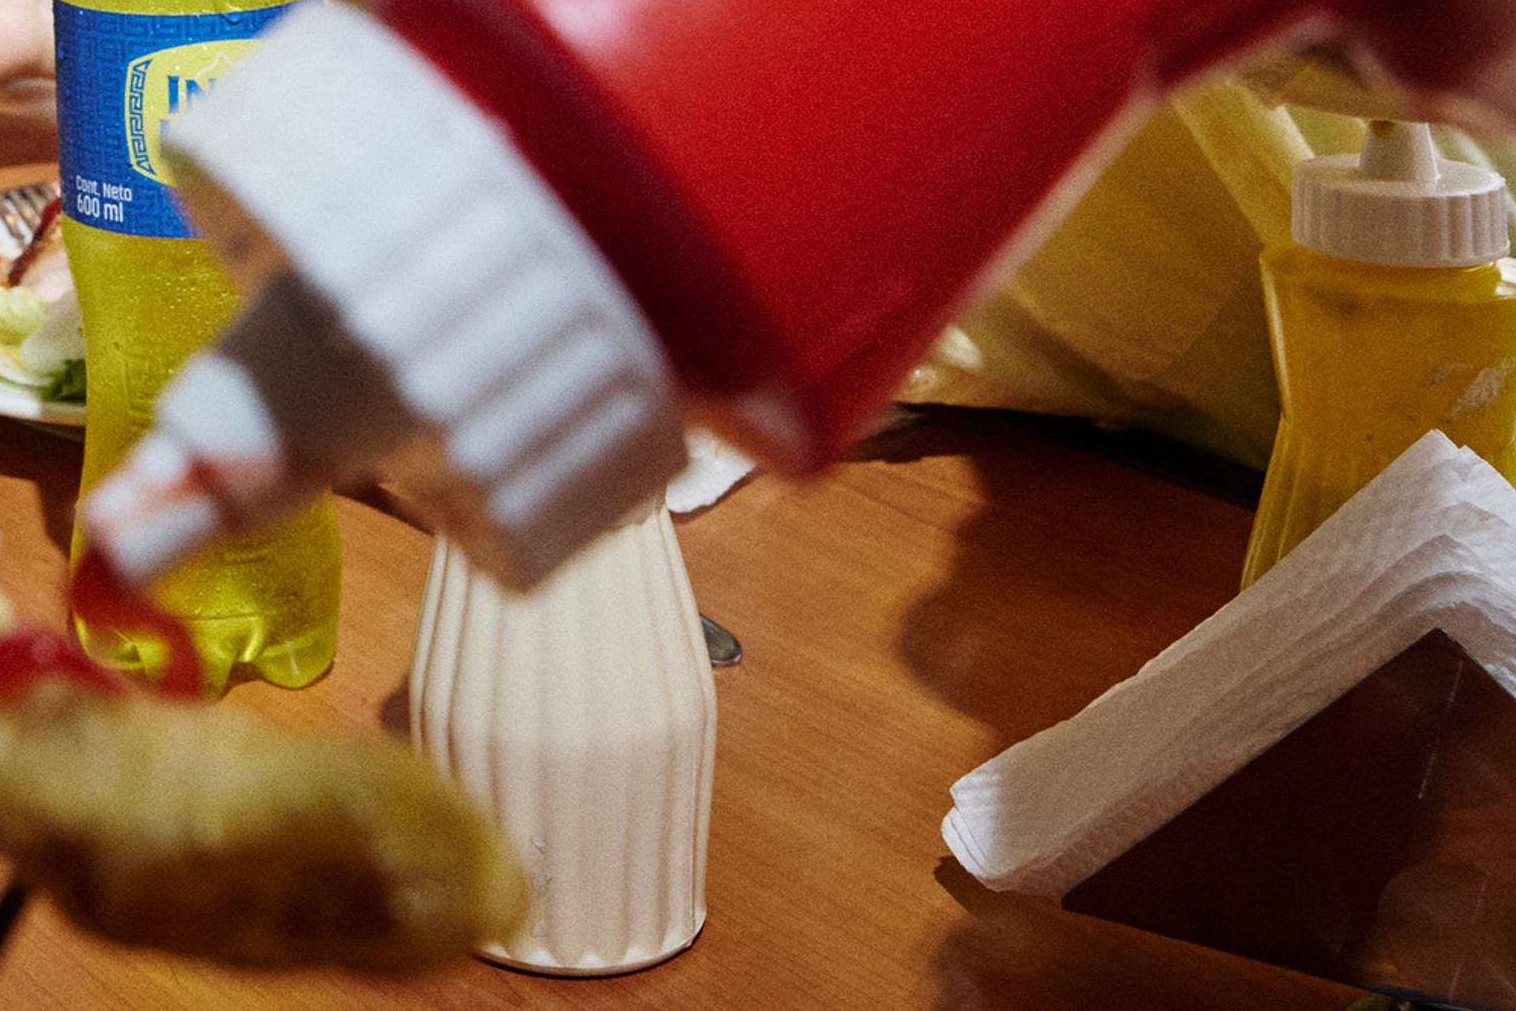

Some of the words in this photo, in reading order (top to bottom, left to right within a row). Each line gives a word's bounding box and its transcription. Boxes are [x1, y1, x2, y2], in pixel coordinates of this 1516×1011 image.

[166, 75, 217, 114] IN
[103, 182, 132, 202] Neto
[77, 193, 100, 218] 600
[104, 201, 124, 222] ml
